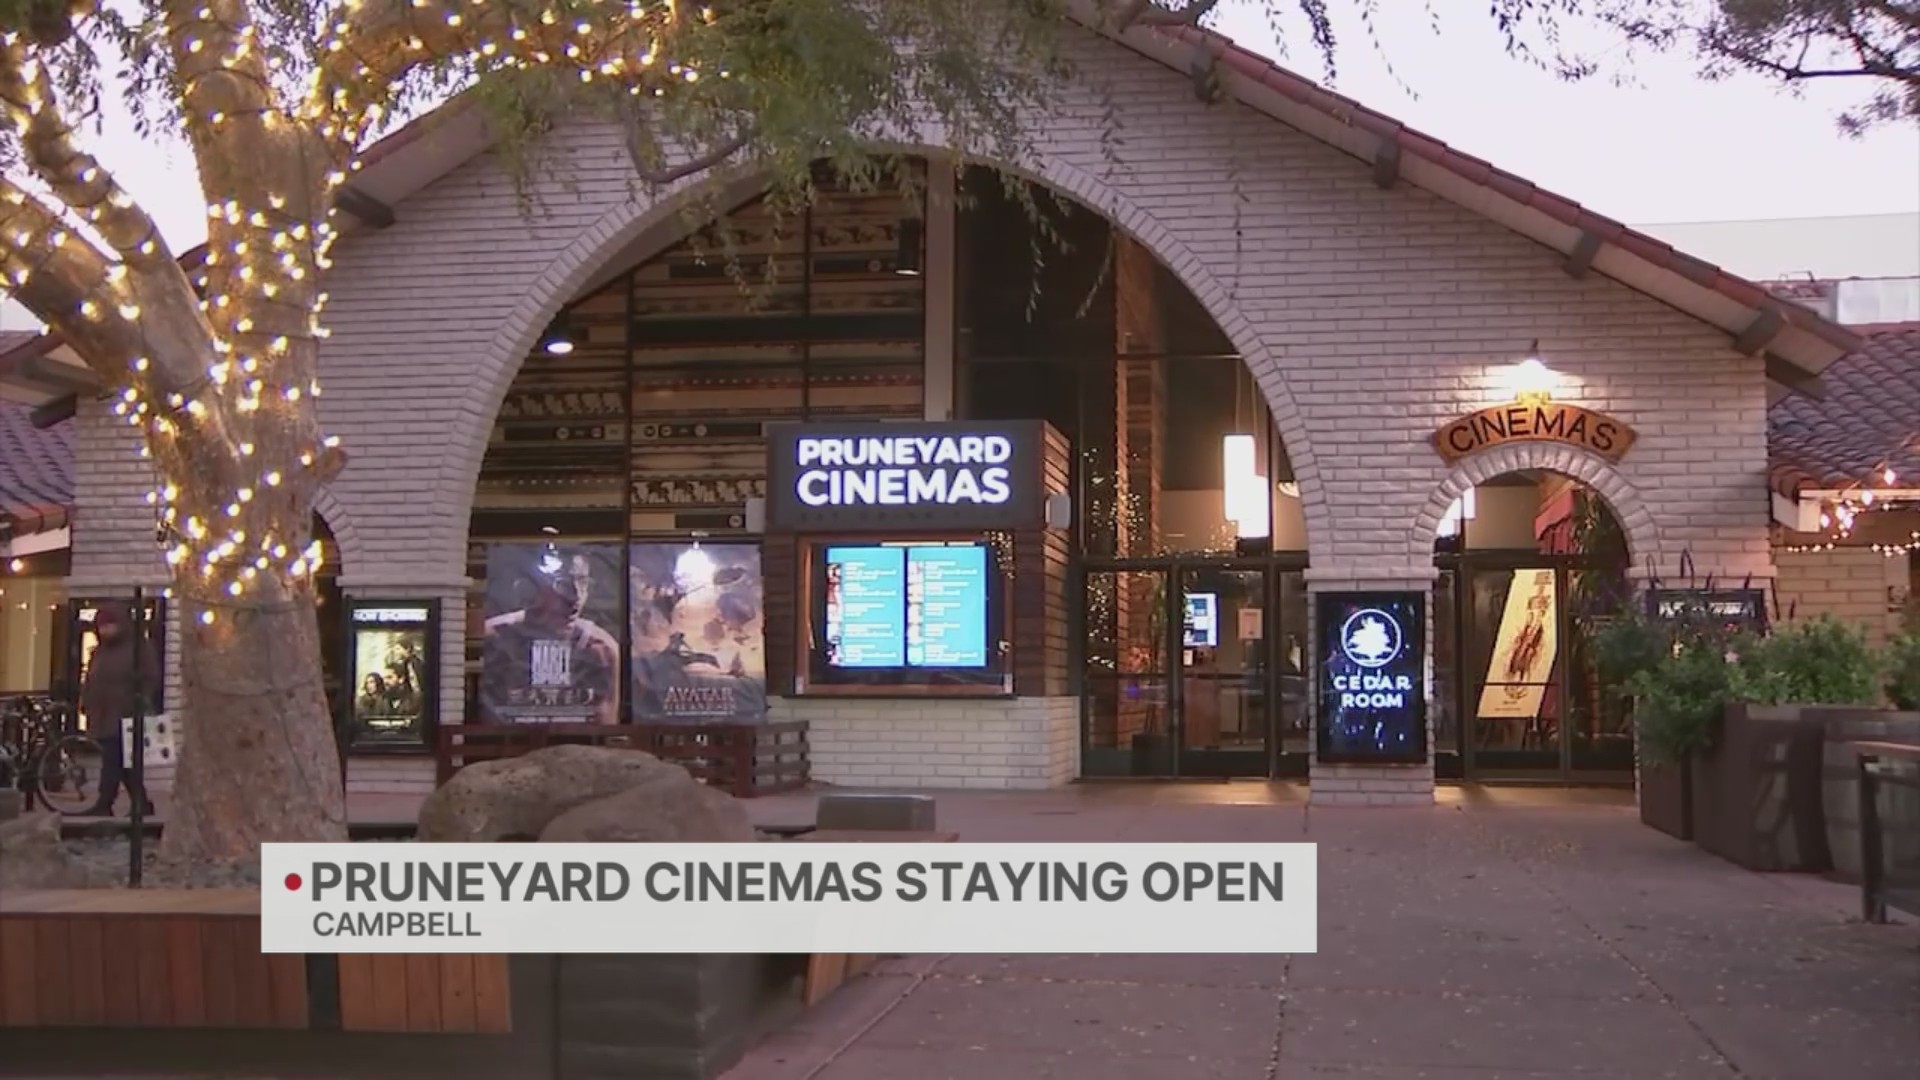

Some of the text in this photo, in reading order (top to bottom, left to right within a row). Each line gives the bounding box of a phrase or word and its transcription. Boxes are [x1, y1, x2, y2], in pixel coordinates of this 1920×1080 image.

[1449, 408, 1617, 451] CINEMAS
[798, 436, 1012, 466] PRUNEYARD
[797, 468, 1011, 506] CINEMAS
[1333, 675, 1412, 690] CEDAR
[664, 686, 735, 703] AVATAR
[1341, 693, 1403, 708] ROOM
